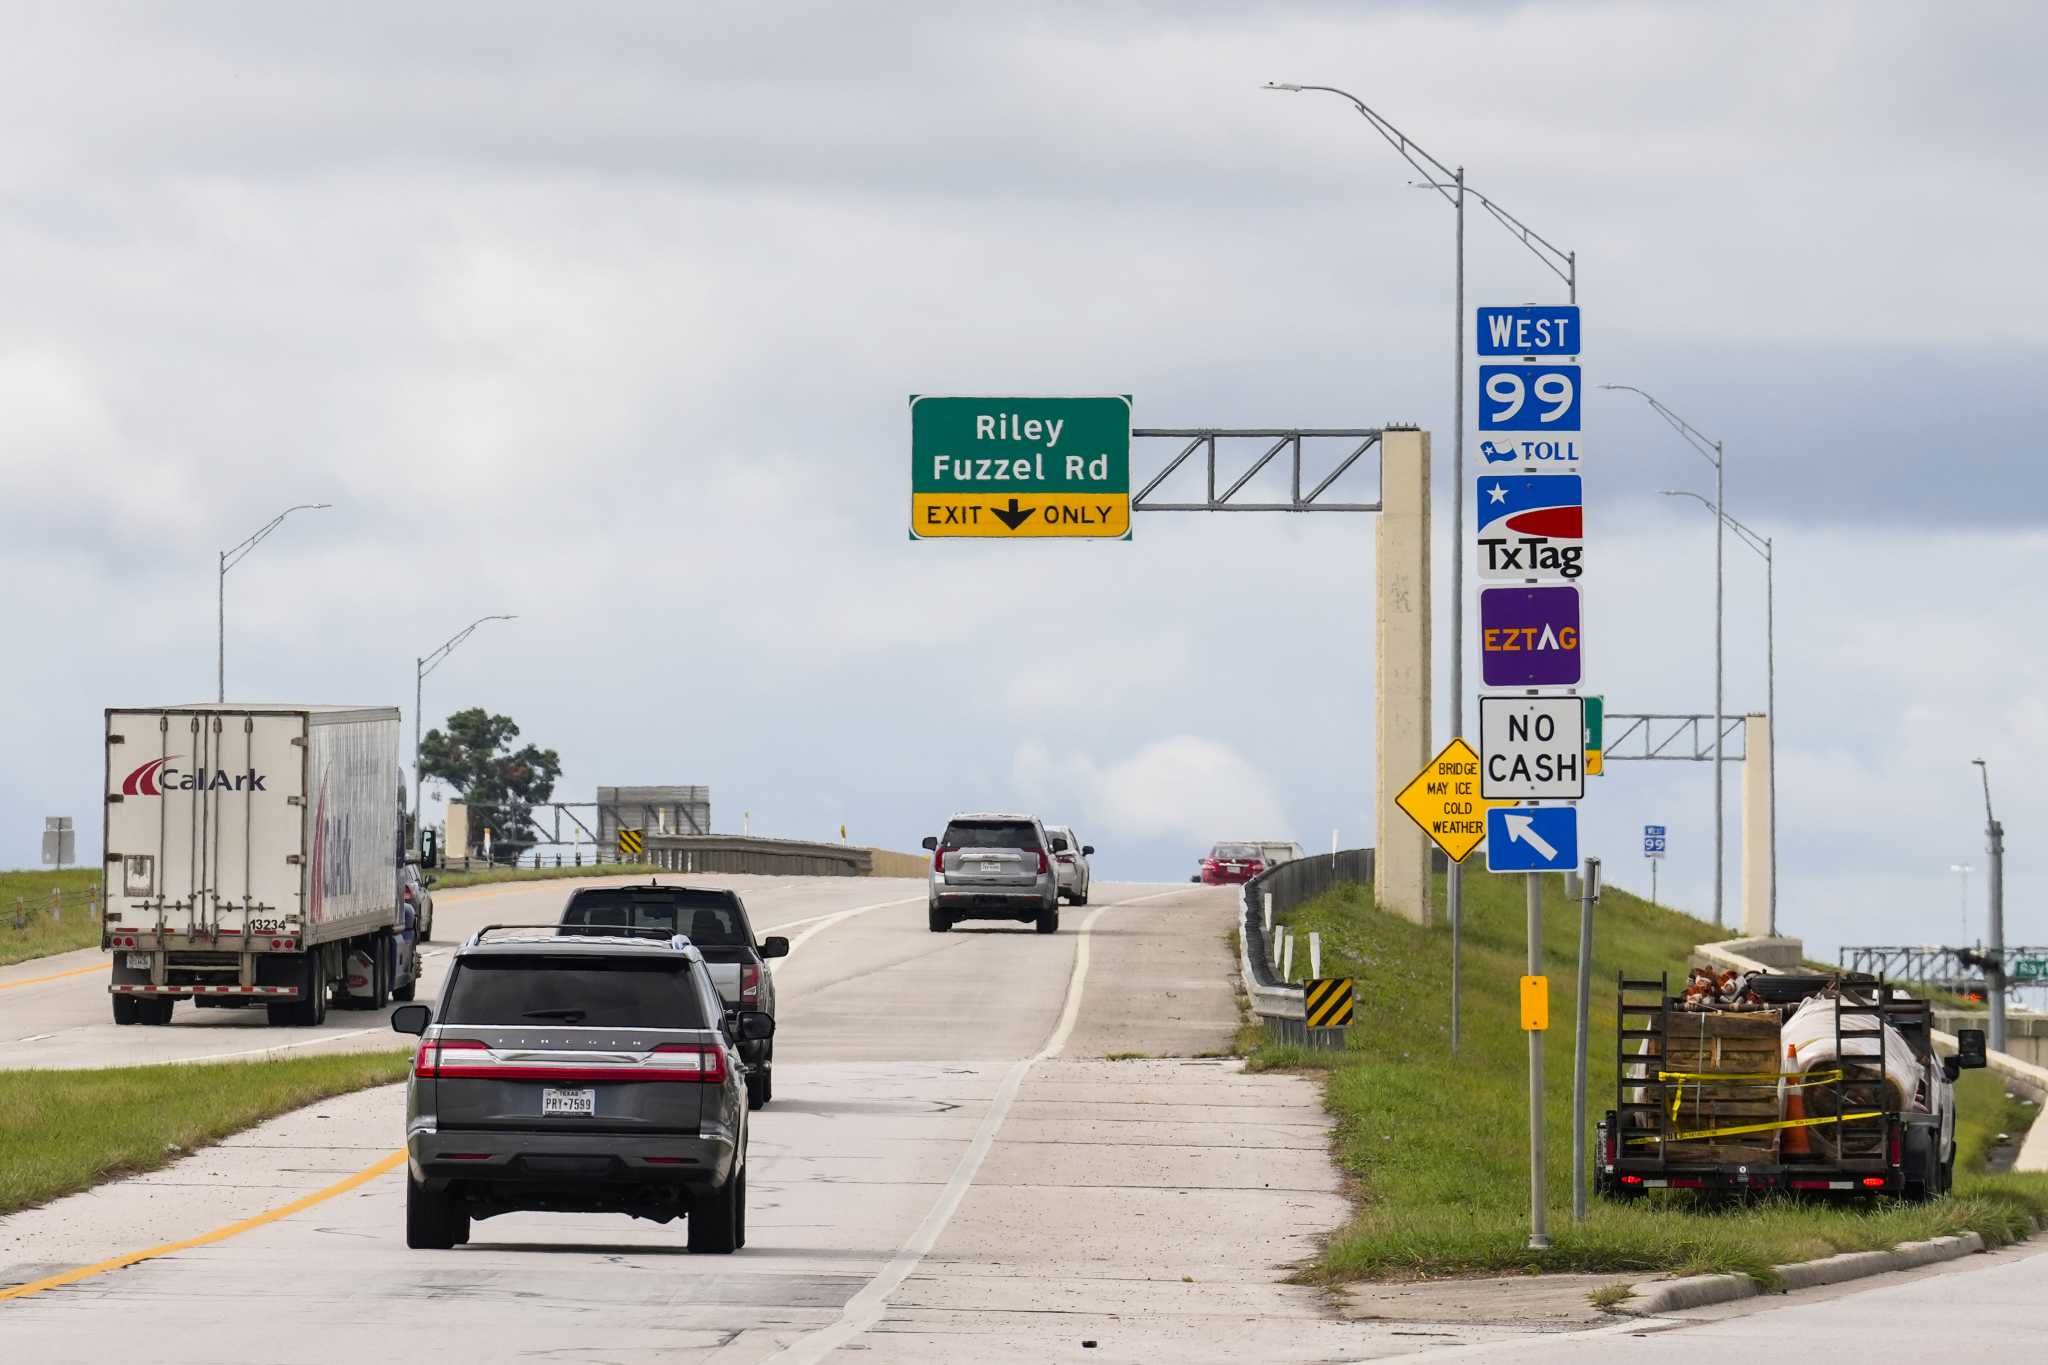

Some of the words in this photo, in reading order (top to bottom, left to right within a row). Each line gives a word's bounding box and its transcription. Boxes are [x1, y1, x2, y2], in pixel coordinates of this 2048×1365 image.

[1488, 315, 1568, 347] WEST
[1485, 373, 1574, 422] 99
[976, 413, 1064, 447] Riley
[1521, 442, 1579, 460] TOLL
[934, 453, 1045, 480] Fuzzel
[1065, 454, 1108, 480] Rd
[927, 506, 982, 524] EXIT
[1044, 506, 1112, 524] ONLY
[1477, 537, 1583, 578] TxTag
[1484, 624, 1577, 651] EZTAG
[1508, 714, 1555, 741] NO
[1438, 762, 1477, 775] BRIDGE
[1488, 754, 1576, 781] CASH
[1427, 782, 1448, 795] MAY
[1455, 782, 1472, 795] ICE
[1444, 802, 1472, 814] COLD
[1433, 821, 1483, 833] WEATHER
[1645, 839, 1664, 850] 99
[250, 919, 286, 930] 13234
